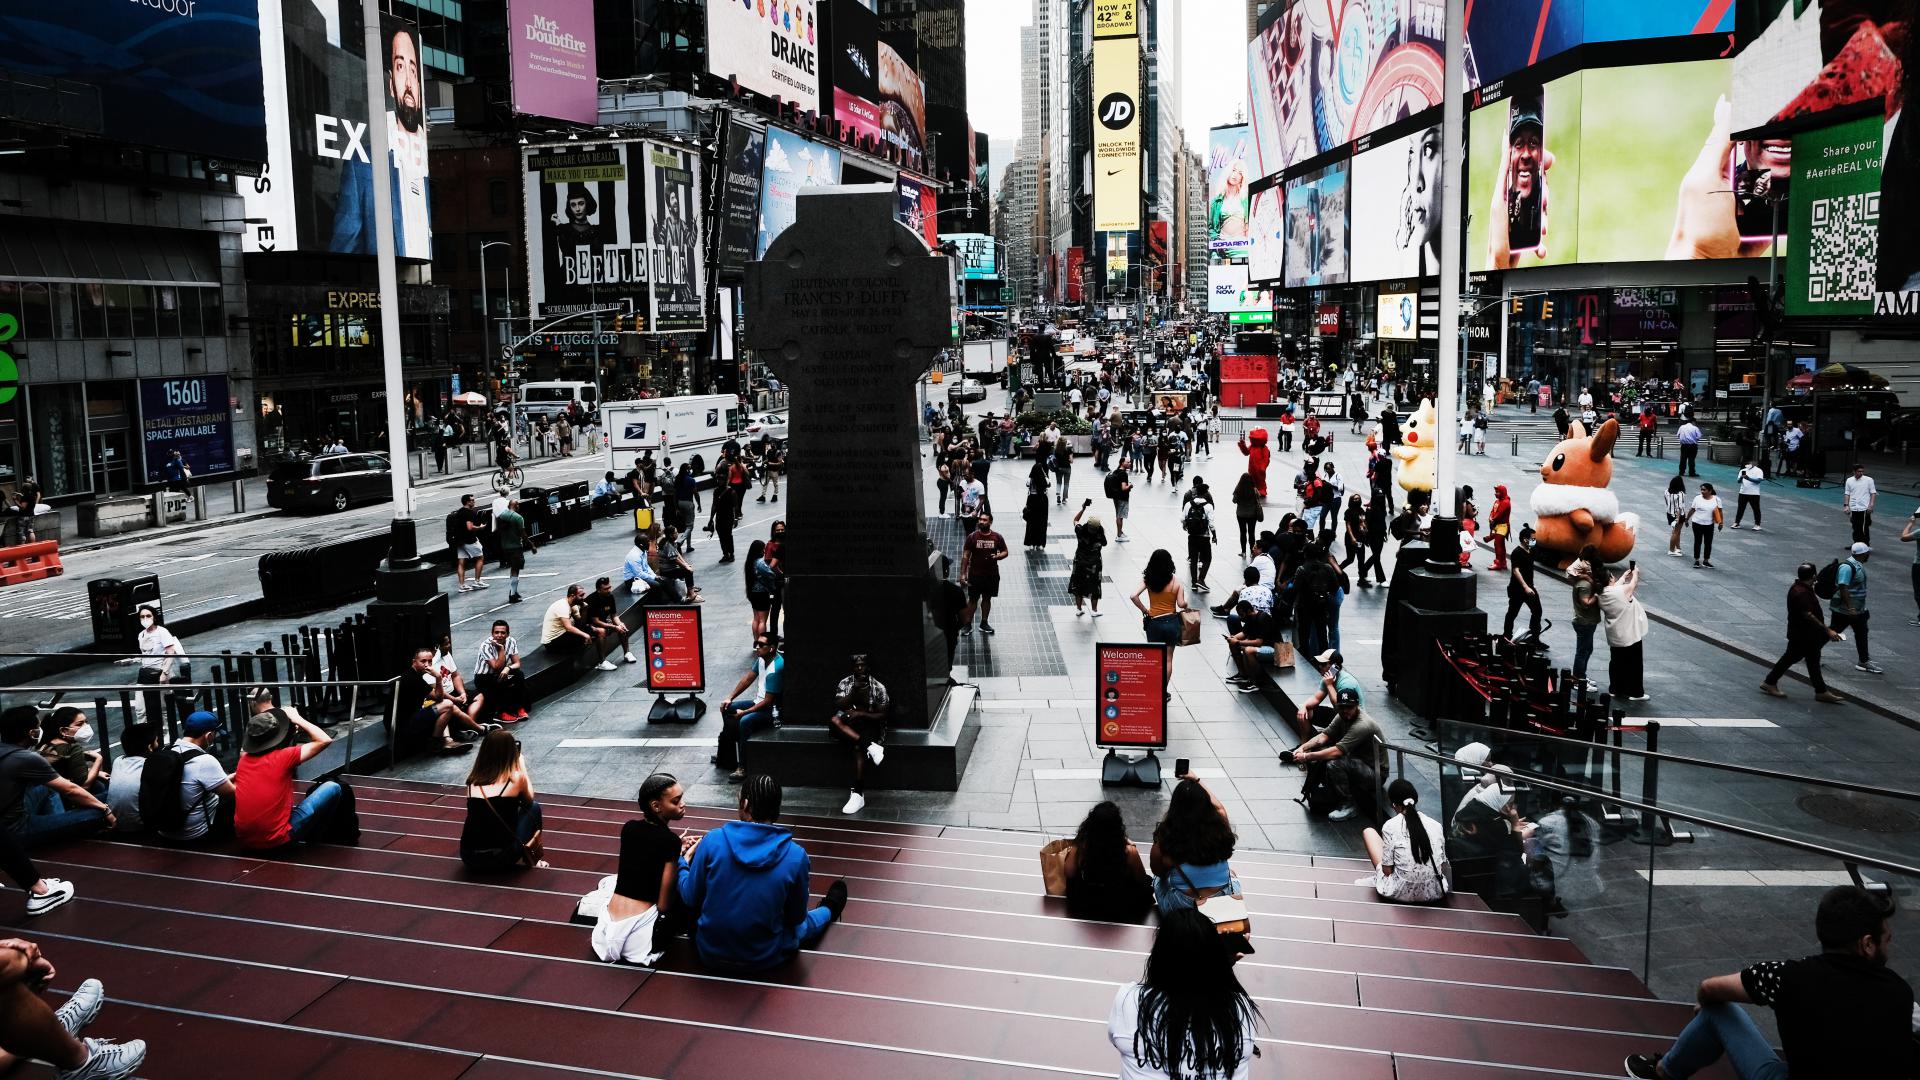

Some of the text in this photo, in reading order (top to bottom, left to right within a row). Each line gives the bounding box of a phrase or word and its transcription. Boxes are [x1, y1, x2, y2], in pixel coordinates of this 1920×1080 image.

[1097, 3, 1133, 12] NOW AT
[1124, 11, 1133, 21] &
[533, 14, 560, 32] Mrs.
[1097, 21, 1133, 29] BROADWAY
[525, 23, 587, 53] Doubtfire
[771, 31, 815, 76] DRAKE
[771, 69, 816, 97] CERTIFIED LOVER BOY
[1102, 100, 1131, 122] JD
[315, 113, 371, 164] EX
[550, 154, 577, 167] SQUARE
[1823, 138, 1877, 169] Share your
[547, 169, 567, 181] MAKE
[568, 168, 583, 180] YOU
[583, 167, 601, 179] FEEL
[1806, 156, 1883, 181] #AerieREAL Voi
[791, 277, 900, 290] LIEUTENANT COLONEL
[784, 291, 842, 306] FRANCIS
[861, 289, 911, 304] DUFFY
[800, 325, 848, 336] CATHOLIC
[164, 380, 201, 406] 1560
[145, 413, 228, 430] RETAIL/RESTAURANT
[851, 423, 898, 433] COUNTRY
[146, 424, 217, 441] SPACE AVAILABLE
[164, 499, 182, 513] PD
[647, 611, 684, 619] Welcome.
[1102, 650, 1146, 660] Welcome.
